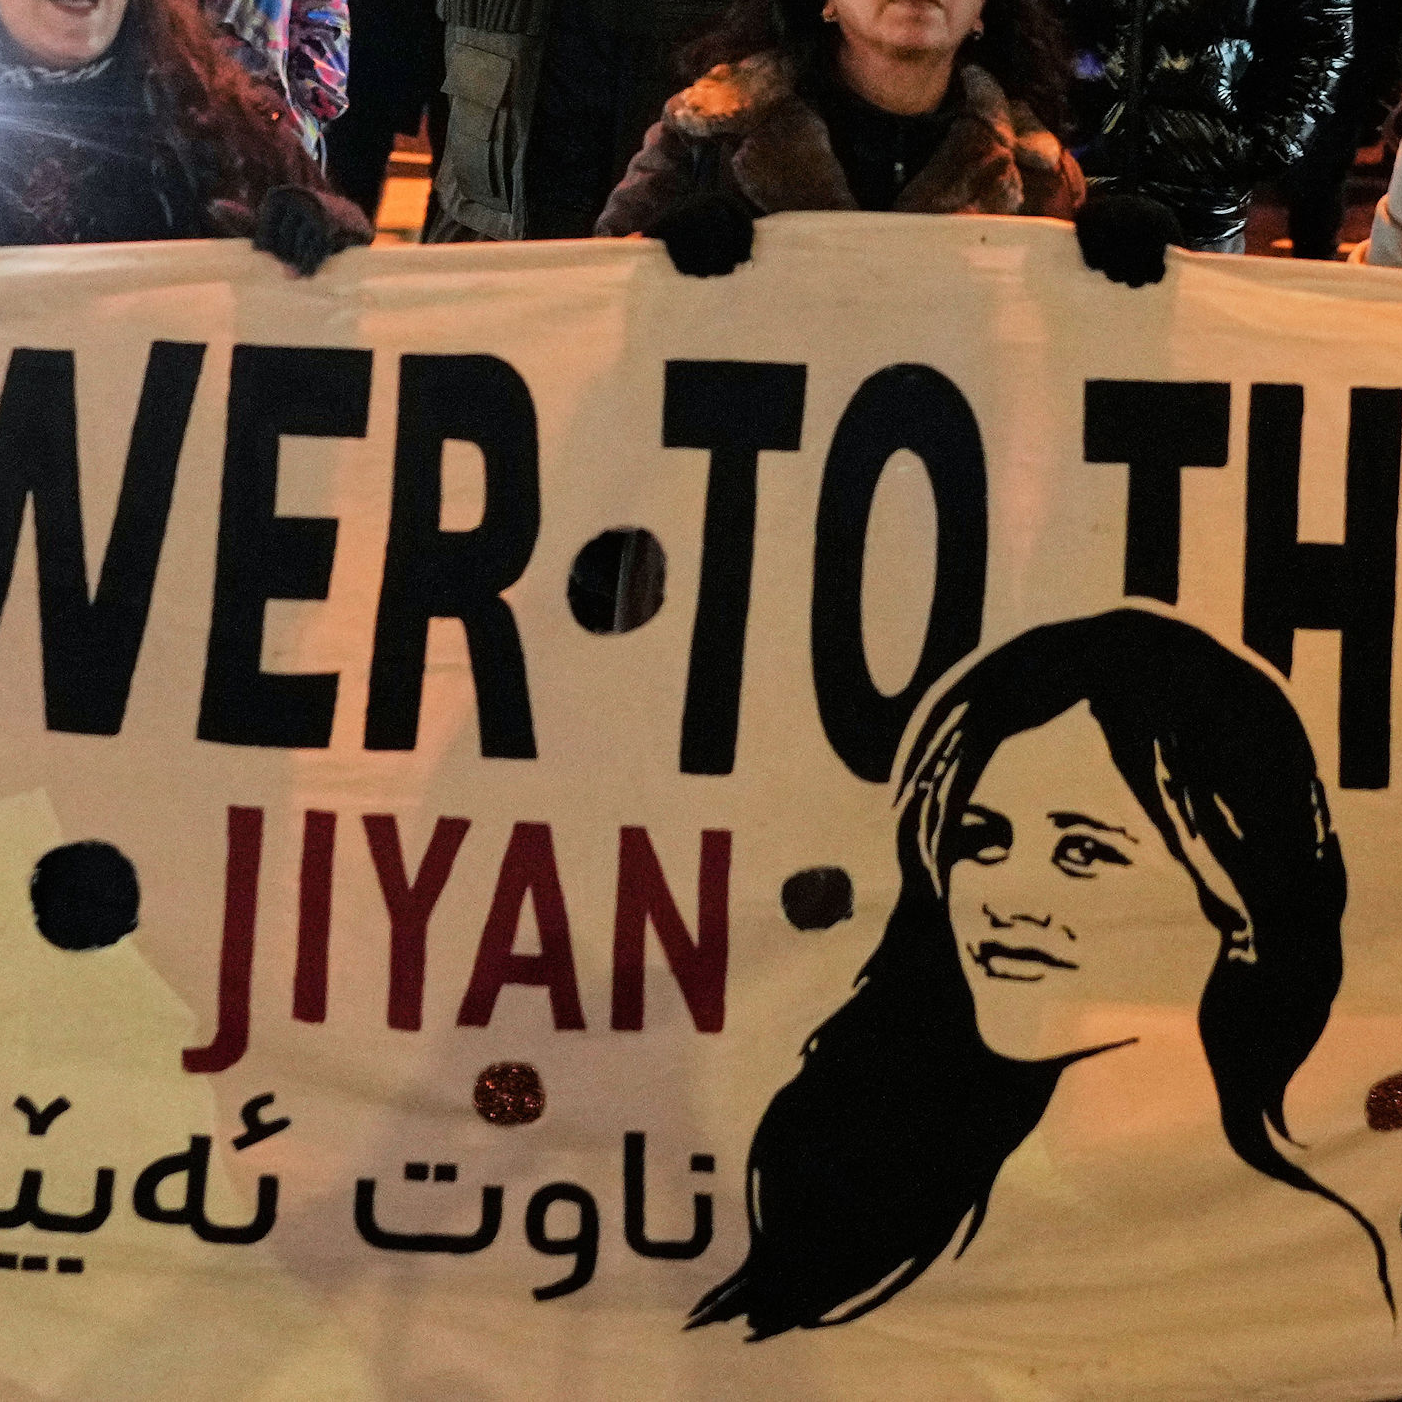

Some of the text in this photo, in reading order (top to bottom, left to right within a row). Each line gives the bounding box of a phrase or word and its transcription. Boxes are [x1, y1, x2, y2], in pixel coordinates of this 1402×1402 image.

[663, 359, 989, 783] TO
[182, 805, 733, 1073] JIYAN
[353, 1130, 717, 1303] ناوت
